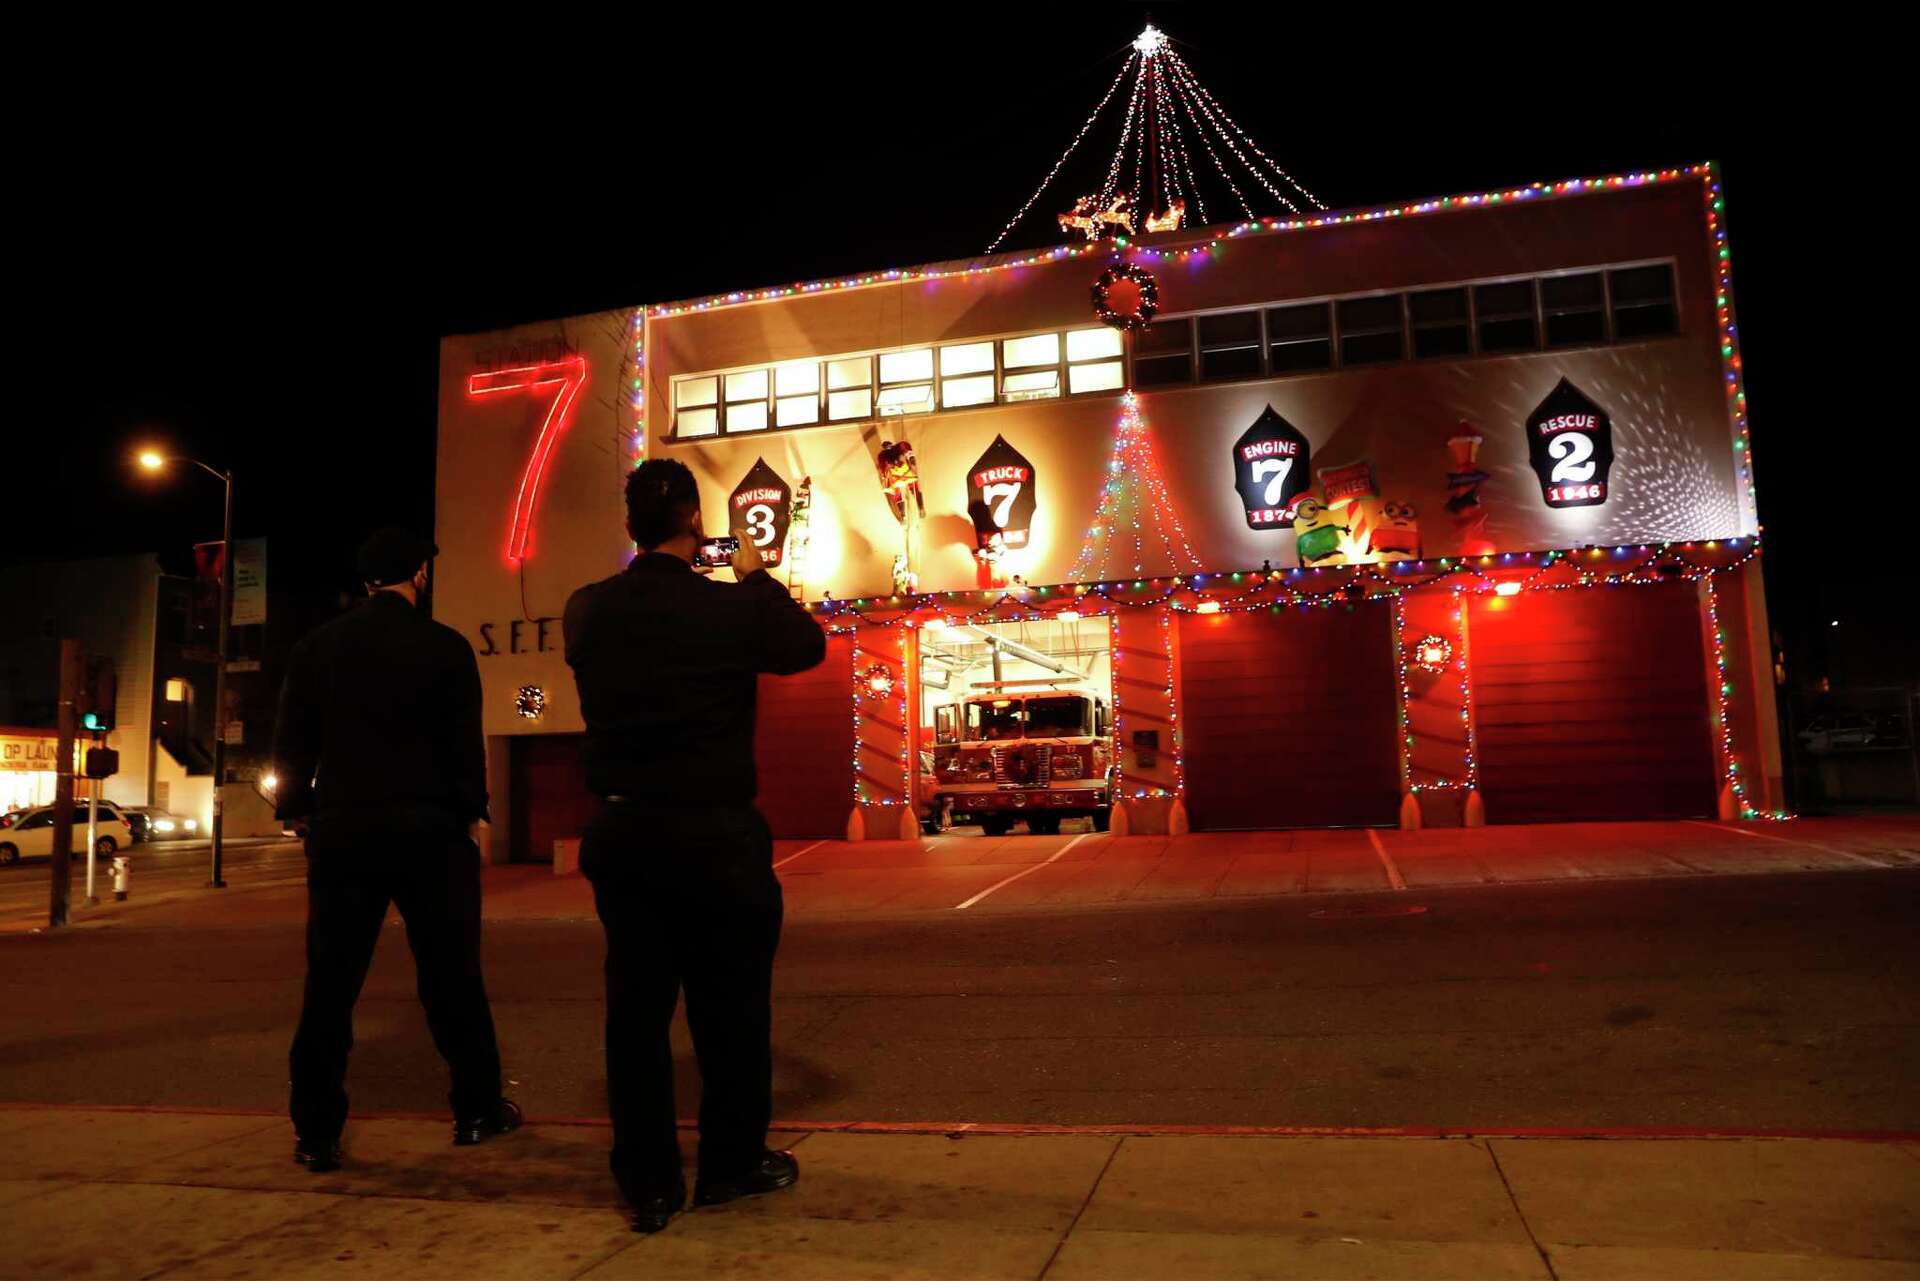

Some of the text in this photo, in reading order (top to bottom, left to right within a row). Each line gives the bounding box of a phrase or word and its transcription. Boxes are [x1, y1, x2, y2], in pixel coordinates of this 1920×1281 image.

[1540, 414, 1595, 434] RESCUE
[469, 357, 586, 560] 7
[1244, 441, 1297, 459] ENGINE
[1548, 432, 1596, 482] 2
[980, 466, 1024, 483] TRUCK
[1252, 458, 1293, 505] 7
[736, 488, 782, 506] DIVISION
[983, 482, 1022, 527] 7
[1550, 485, 1600, 501] 1946
[746, 504, 775, 546] 3
